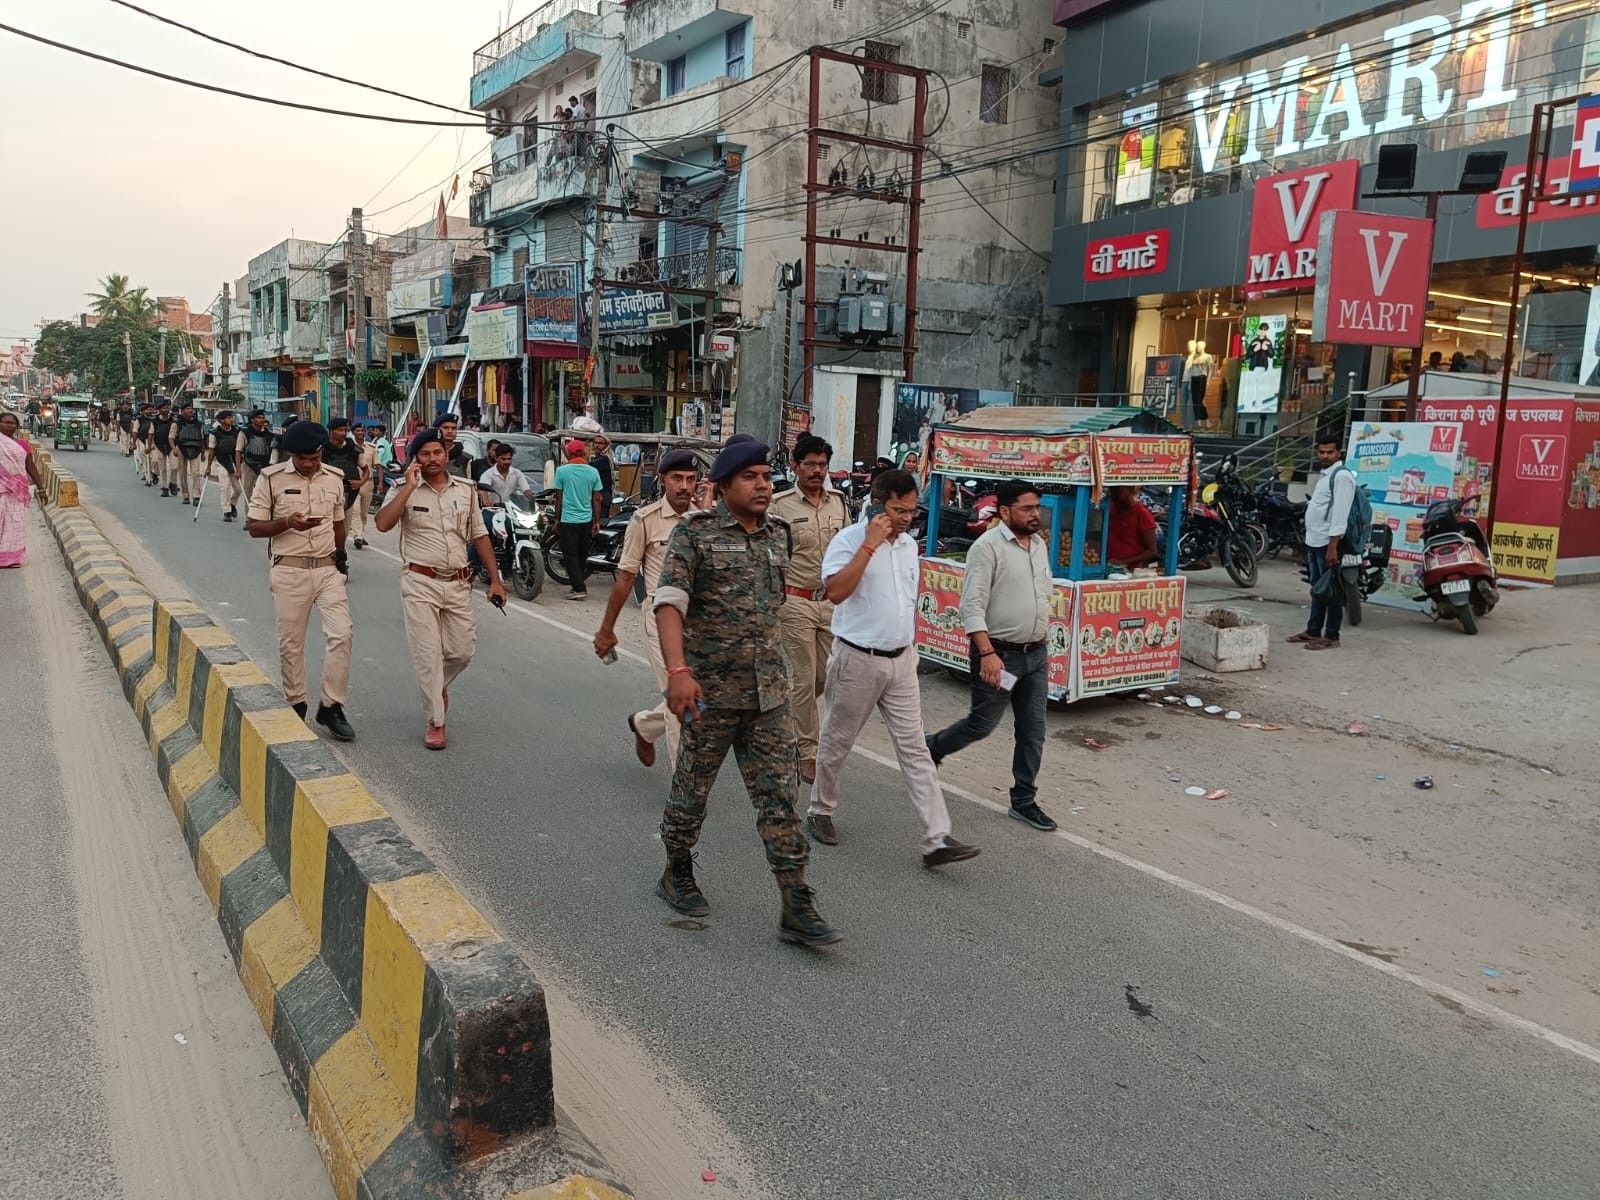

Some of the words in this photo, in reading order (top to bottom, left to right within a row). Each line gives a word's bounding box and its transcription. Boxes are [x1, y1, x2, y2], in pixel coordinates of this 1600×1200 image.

[1273, 172, 1330, 242] V
[1091, 244, 1116, 274] वी
[1117, 235, 1159, 270] मार्ट
[1248, 248, 1317, 284] MAR
[1360, 228, 1408, 297] V
[1338, 299, 1414, 332] MART
[1425, 405, 1458, 421] किराना
[1460, 405, 1476, 421] की
[1478, 405, 1496, 426] पूरी
[1520, 409, 1563, 422] उपलब्ध
[1439, 428, 1452, 443] V
[1359, 444, 1395, 456] MONSOON
[1531, 439, 1555, 463] V
[1521, 463, 1558, 477] MART
[1493, 530, 1524, 549] आकर्षक
[1526, 533, 1554, 552] ऑफर्स
[1493, 553, 1504, 566] का
[1506, 554, 1523, 569] लाभ
